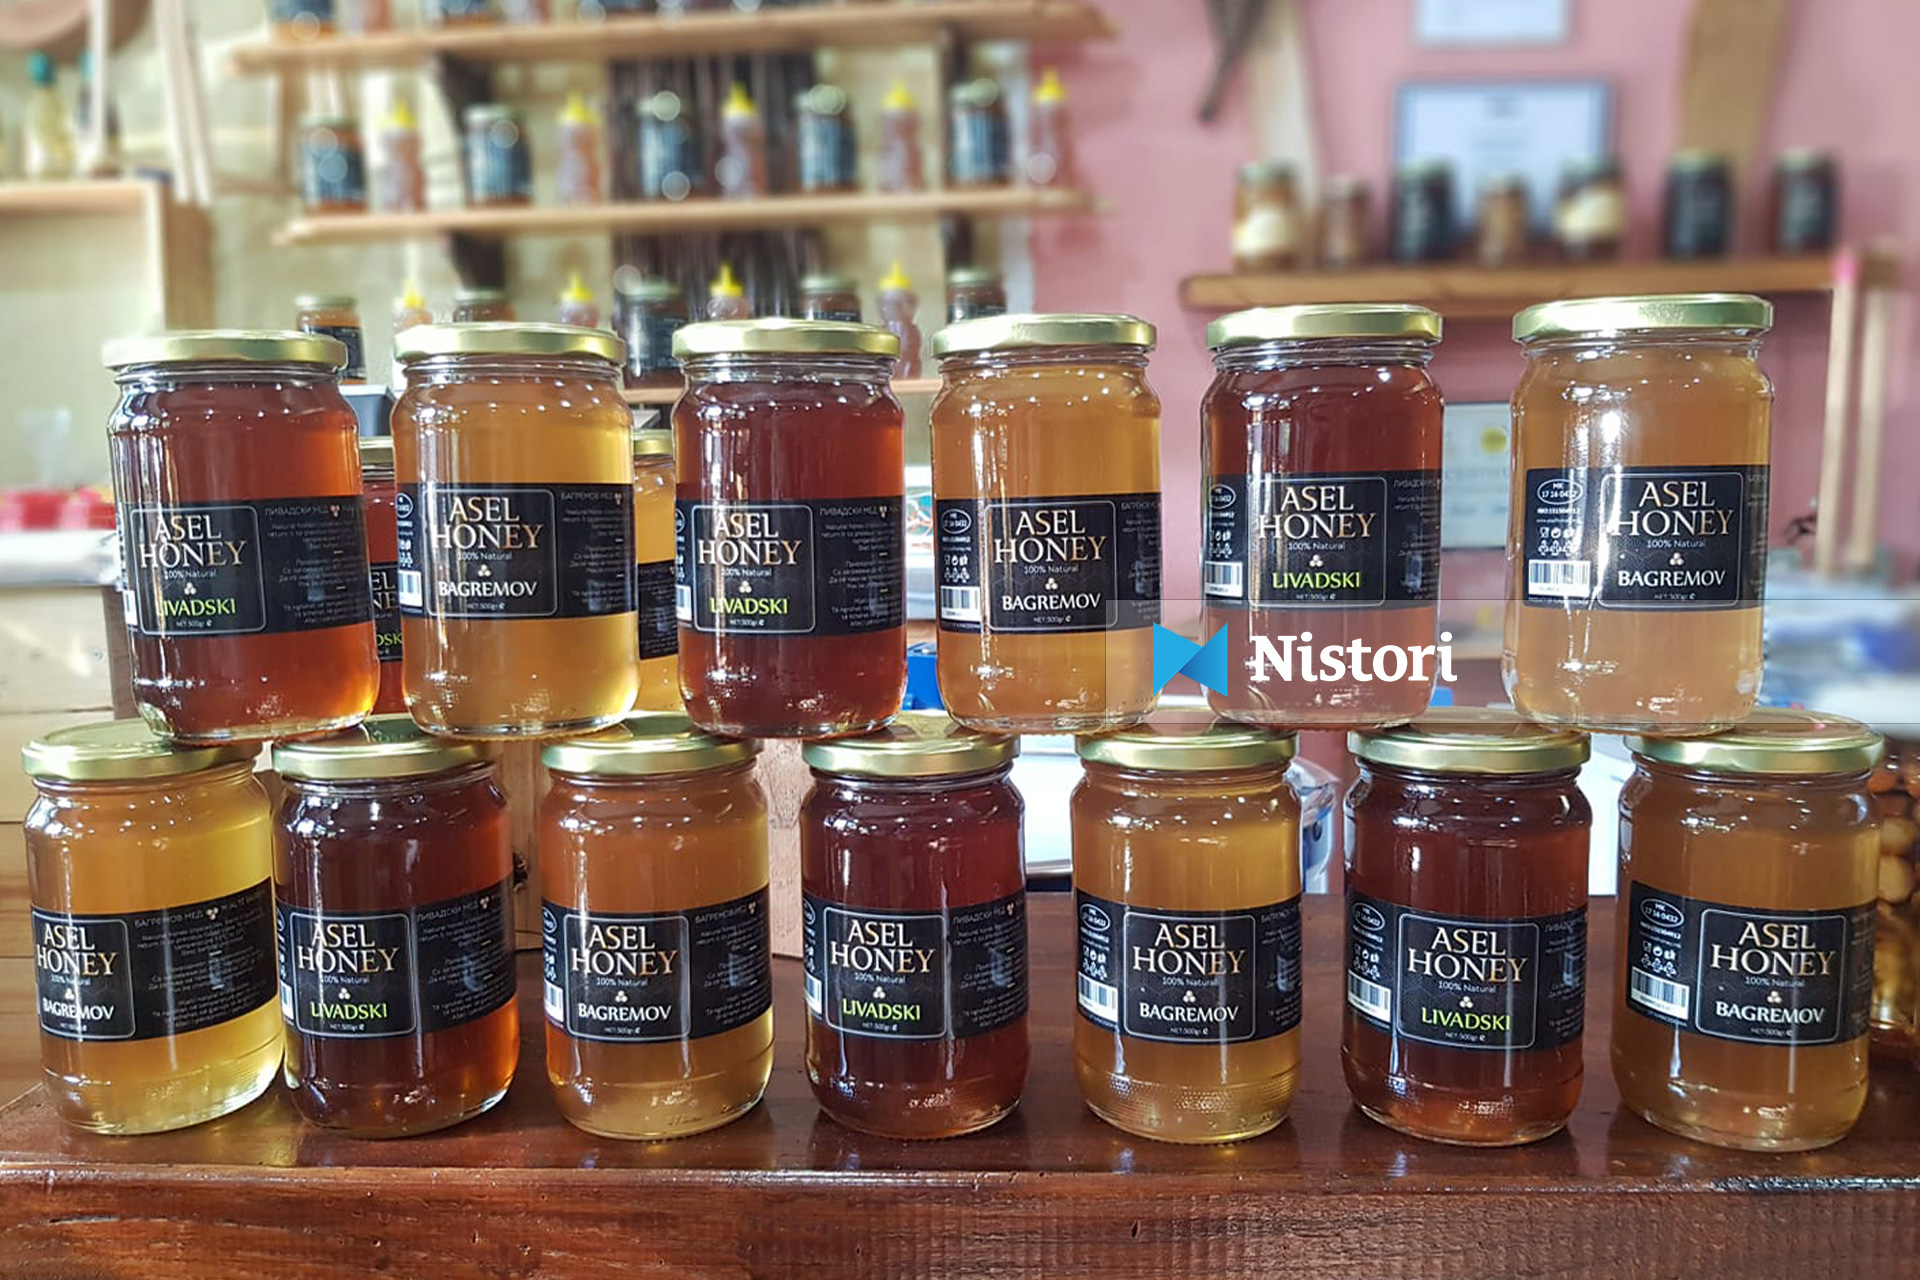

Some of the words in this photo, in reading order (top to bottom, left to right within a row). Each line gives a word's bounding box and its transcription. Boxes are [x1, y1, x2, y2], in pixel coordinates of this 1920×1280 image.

[1281, 486, 1354, 512] ASEL
[1639, 481, 1715, 507] ASEL
[450, 497, 520, 522] ASEL
[154, 515, 222, 541] ASEL
[714, 513, 778, 539] ASEL
[1016, 510, 1085, 535] ASEL
[1258, 513, 1376, 539] HONEY
[1611, 509, 1735, 536] HONEY
[433, 524, 544, 549] HONEY
[1288, 542, 1310, 550] 100%
[1313, 541, 1345, 550] Natural
[1647, 539, 1671, 548] 100%
[1674, 539, 1706, 548] Natural
[140, 540, 247, 568] HONEY
[457, 552, 478, 561] 100%
[481, 551, 513, 560] Natural
[698, 540, 802, 565] HONEY
[994, 535, 1106, 563] HONEY
[164, 570, 184, 579] 100%
[185, 569, 217, 578] Natural
[371, 572, 395, 590] EL
[721, 568, 741, 577] 100%
[742, 567, 772, 576] Natural
[1024, 565, 1046, 574] 100%
[1048, 564, 1079, 573] Natural
[1273, 572, 1360, 589] LIVADSKI
[1618, 570, 1725, 587] BAGREMOV
[439, 581, 537, 597] BAGREMOV
[710, 597, 789, 615] LIVADSKI
[1002, 593, 1101, 611] BAGREMOV
[44, 923, 95, 950] ASEL
[311, 923, 375, 947] ASEL
[588, 925, 655, 949] ASEL
[848, 919, 913, 947] ASEL
[1155, 923, 1225, 949] ASEL
[1431, 927, 1507, 956] ASEL
[1738, 922, 1815, 949] ASEL
[37, 944, 119, 976] HONEY
[298, 946, 399, 974] HONEY
[571, 948, 678, 976] HONEY
[830, 941, 935, 973] HONEY
[1133, 946, 1246, 976] HONEY
[1407, 948, 1528, 983] HONEY
[1710, 944, 1835, 976] HONEY
[341, 975, 370, 983] Natural
[597, 977, 616, 986] 100%
[618, 978, 648, 987] Natural
[854, 973, 875, 982] 100%
[876, 974, 906, 983] Natural
[1162, 977, 1185, 986] 100%
[1186, 978, 1217, 987] Natural
[1438, 980, 1462, 991] 100%
[1463, 983, 1496, 993] Natural
[1745, 976, 1770, 986] 100%
[1772, 978, 1805, 988] Natural
[43, 997, 114, 1021] BAGREMOV
[310, 1001, 388, 1020] LIVADSKI
[578, 1003, 671, 1021] BAGREMOV
[843, 998, 921, 1020] LIVADSKI
[1139, 1002, 1239, 1022] BAGREMOV
[1421, 1007, 1511, 1031] LIVADSKI
[1716, 1001, 1825, 1024] BAGREMOV
